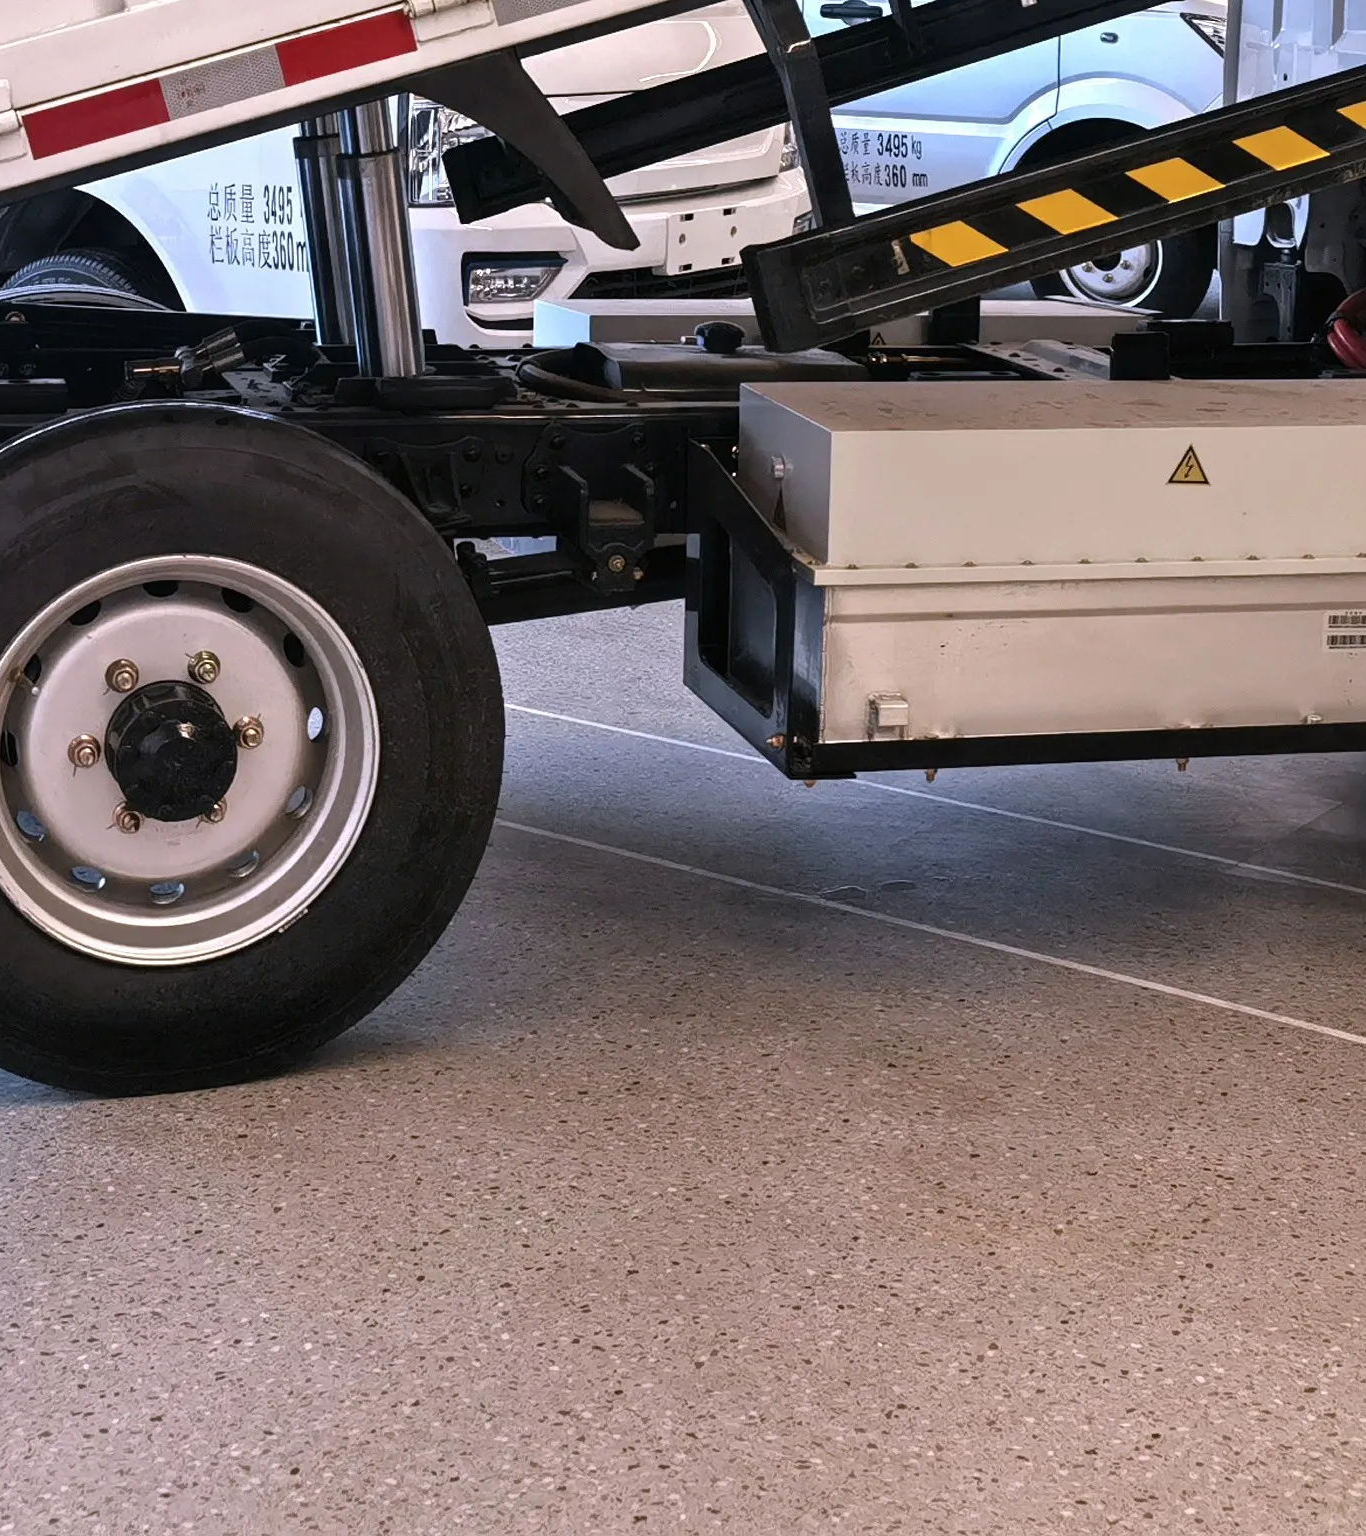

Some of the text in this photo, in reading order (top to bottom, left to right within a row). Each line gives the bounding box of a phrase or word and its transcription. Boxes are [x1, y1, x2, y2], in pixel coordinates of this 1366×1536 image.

[840, 131, 922, 160] 总质量 3495 kg
[912, 172, 928, 187] mm
[207, 182, 255, 223] 总质量
[263, 184, 293, 225] 3495
